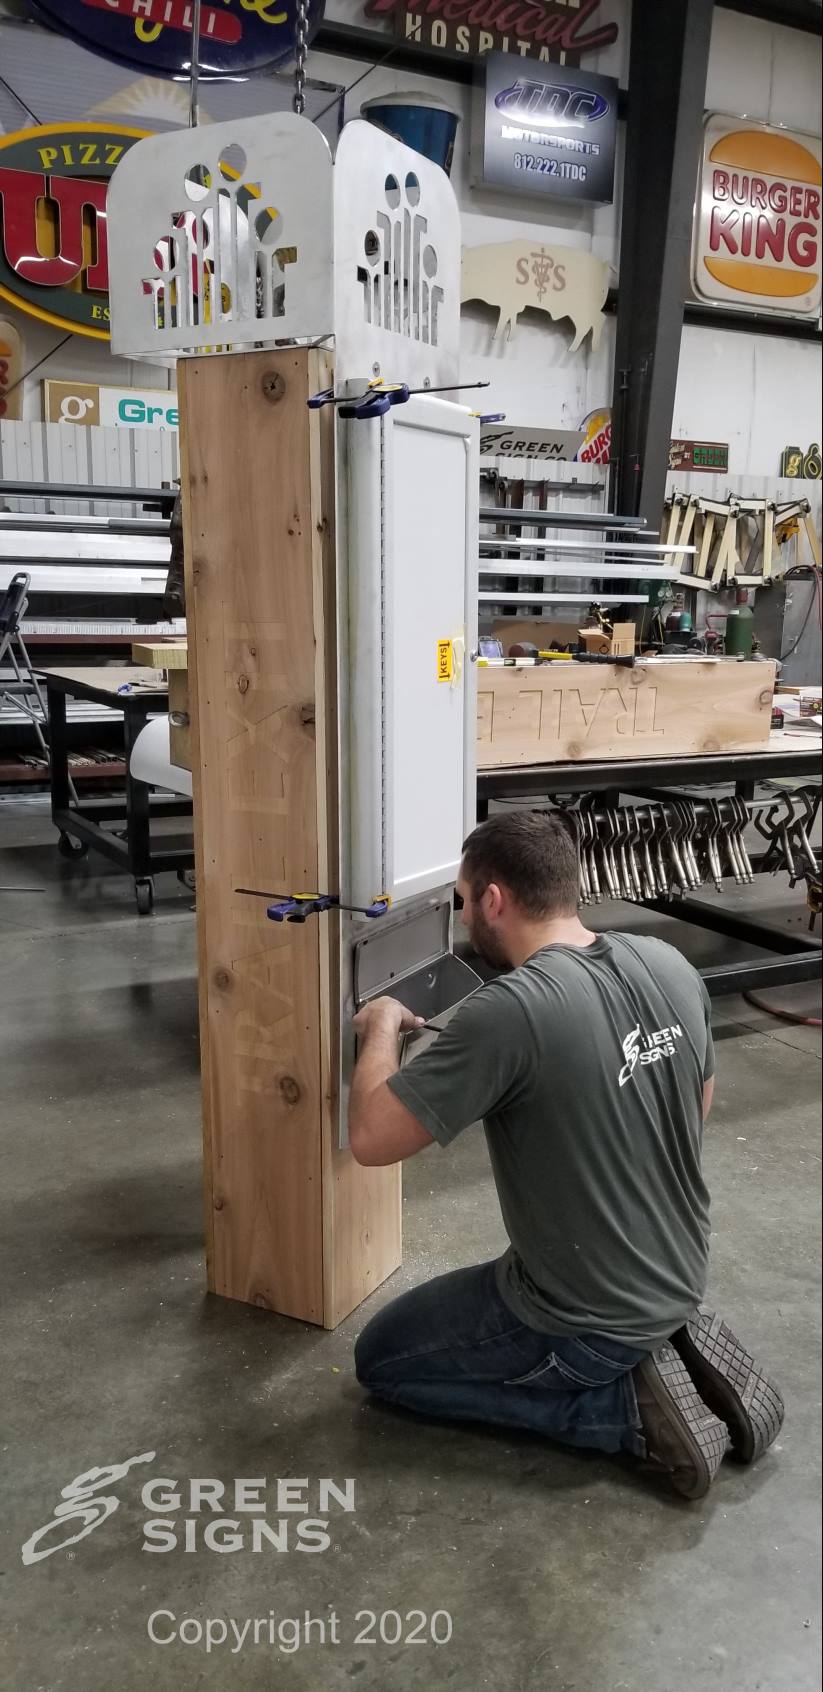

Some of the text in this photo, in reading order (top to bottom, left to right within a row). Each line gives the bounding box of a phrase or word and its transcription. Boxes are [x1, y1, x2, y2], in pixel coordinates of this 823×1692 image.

[371, 0, 618, 49] edical
[511, 79, 598, 122] TDC
[514, 152, 588, 181] 812.222.1TDC
[712, 169, 821, 220] BURGER
[709, 205, 818, 268] KING
[500, 440, 564, 454] GREEN
[440, 646, 449, 674] KEYS
[518, 687, 664, 740] TRAIL
